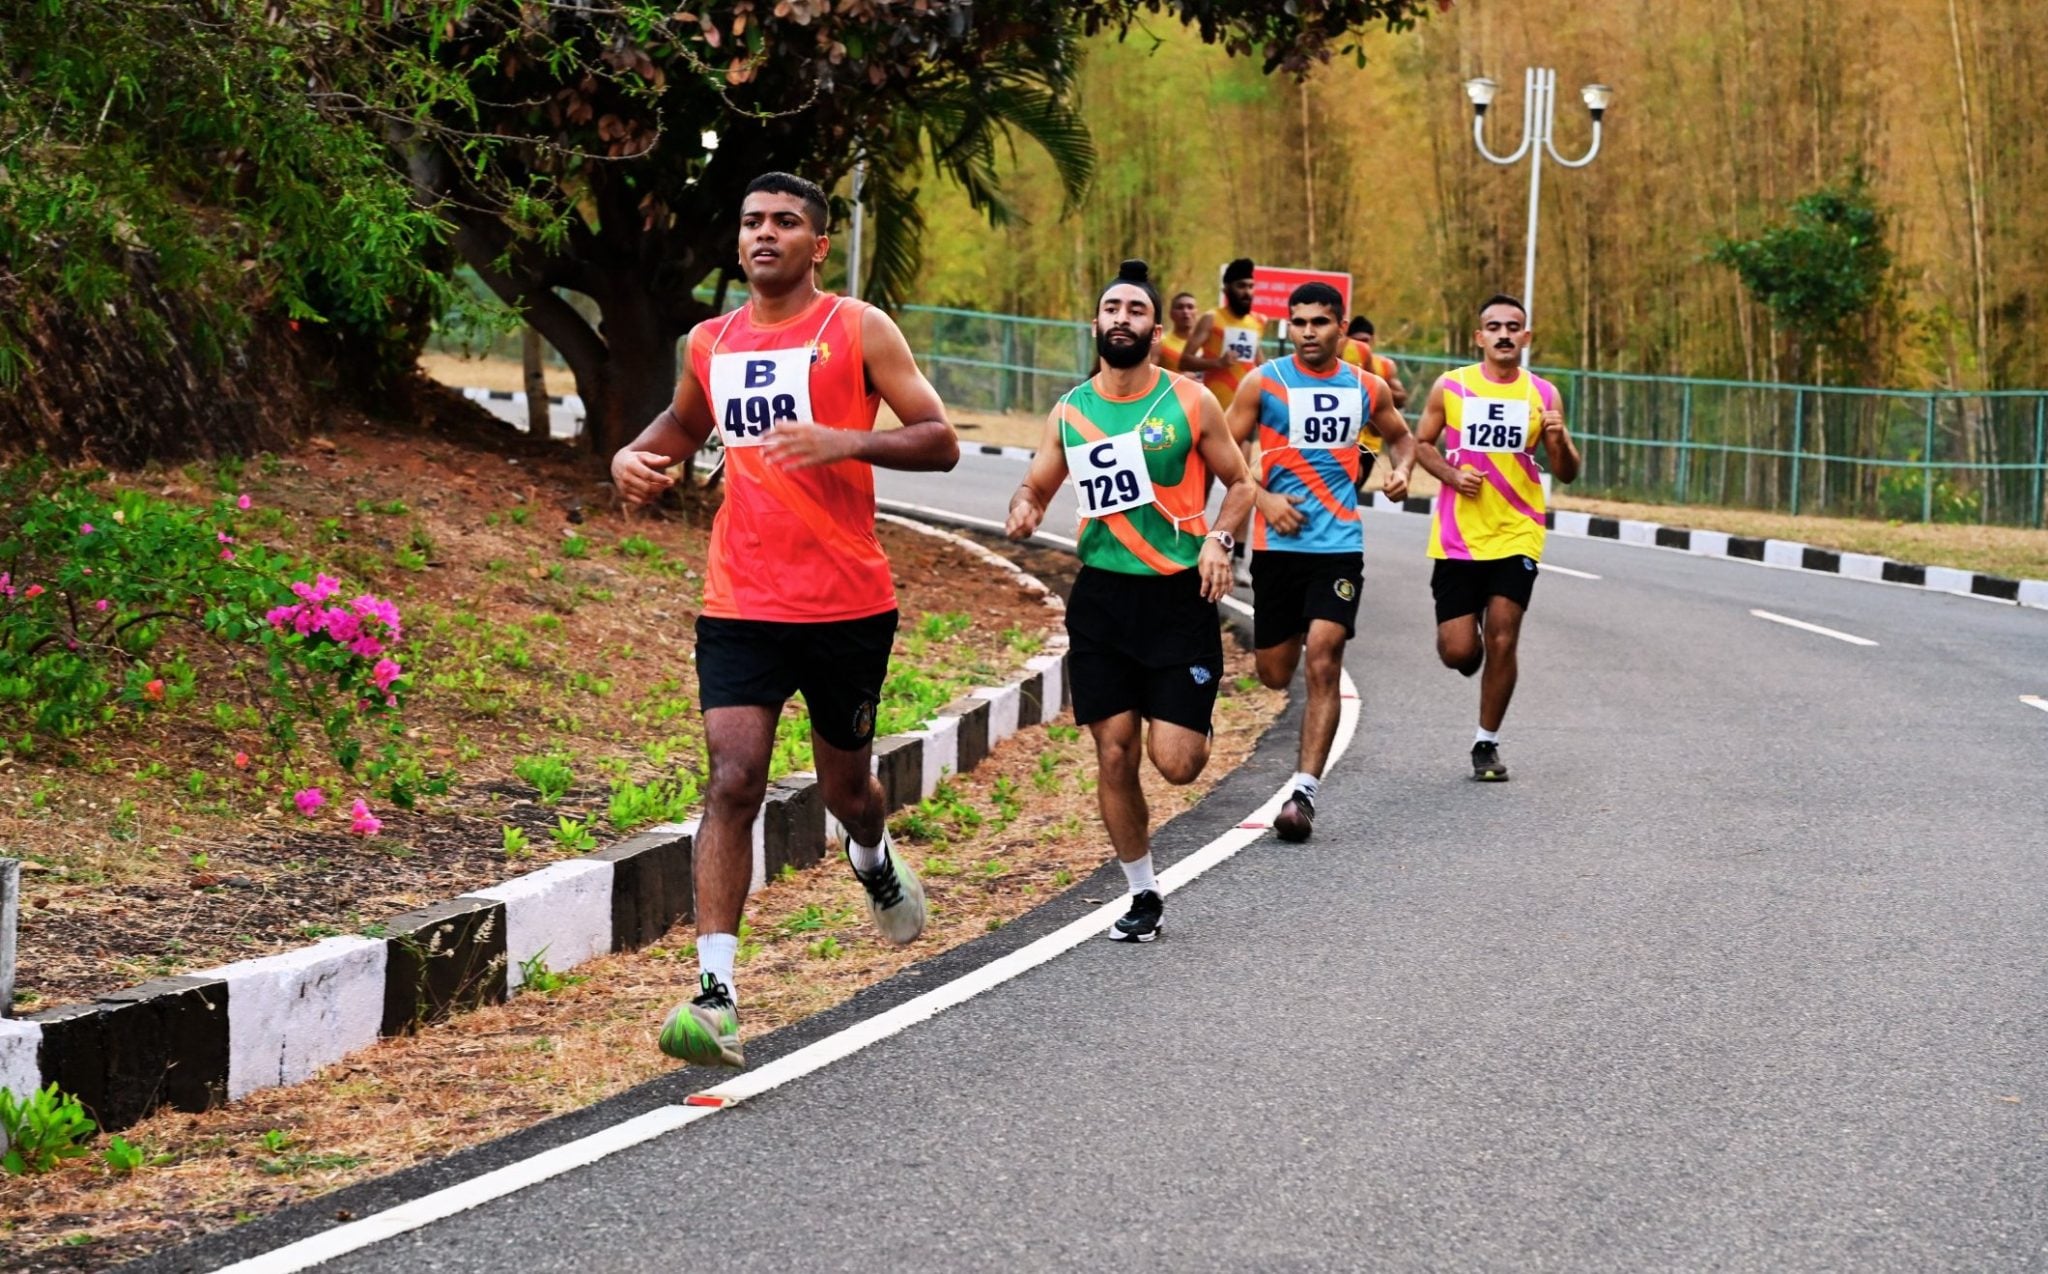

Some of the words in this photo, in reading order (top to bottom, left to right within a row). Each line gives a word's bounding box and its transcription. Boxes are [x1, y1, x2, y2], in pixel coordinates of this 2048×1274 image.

[1238, 331, 1247, 341] A
[744, 359, 777, 389] B
[724, 393, 798, 438] 498
[1313, 393, 1339, 412] D
[1488, 403, 1505, 421] E
[1304, 416, 1351, 443] 937
[1467, 423, 1522, 448] 1285
[1089, 442, 1117, 469] C
[1079, 469, 1140, 511] 129
